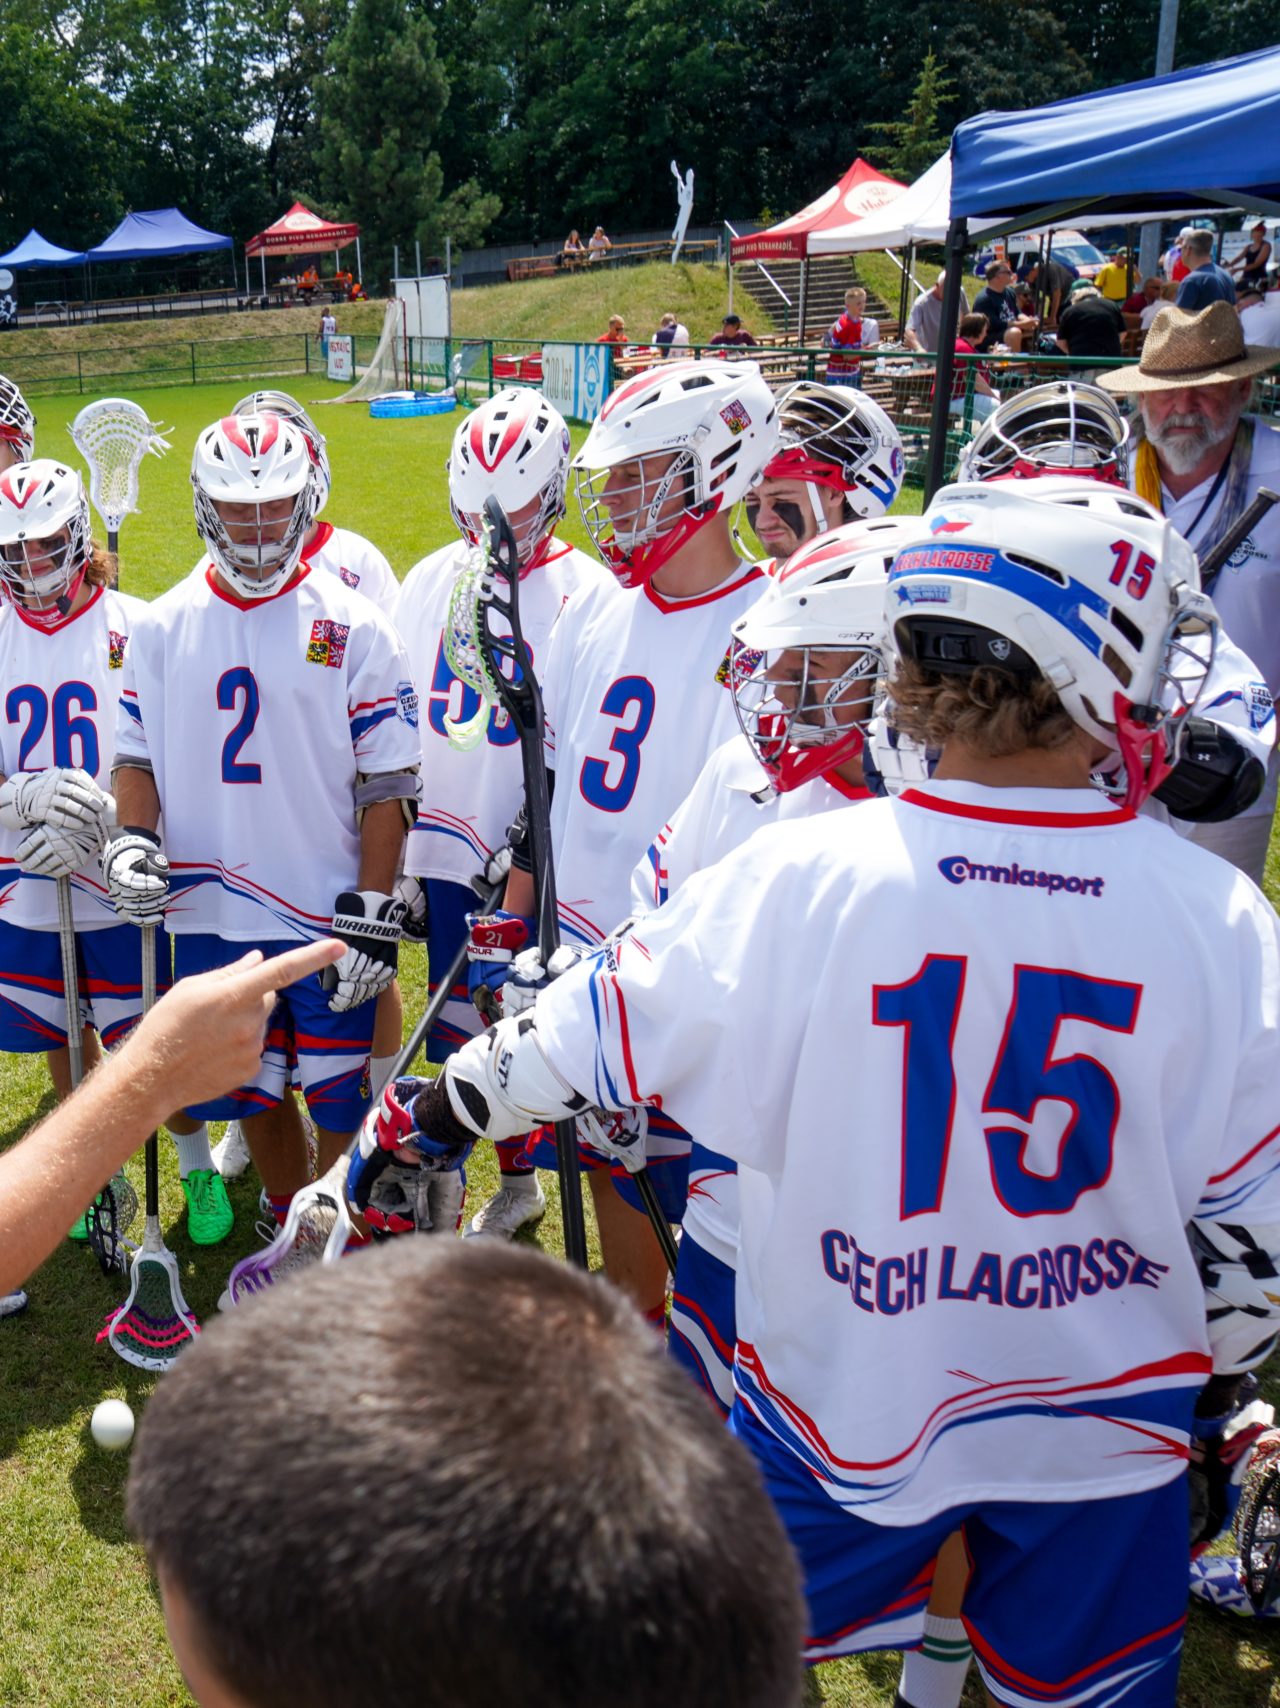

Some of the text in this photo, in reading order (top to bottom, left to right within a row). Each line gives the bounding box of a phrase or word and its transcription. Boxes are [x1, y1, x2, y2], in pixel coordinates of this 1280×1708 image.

[561, 357, 572, 401] let
[922, 550, 995, 572] LACROSSE
[1108, 538, 1157, 601] 15
[5, 680, 100, 777] 26
[217, 665, 262, 785] 2
[578, 674, 656, 813] 3
[334, 917, 401, 938] WARRIOR
[485, 930, 503, 947] 21
[872, 952, 1144, 1222] 15
[937, 1237, 1170, 1310] LACROSSE
